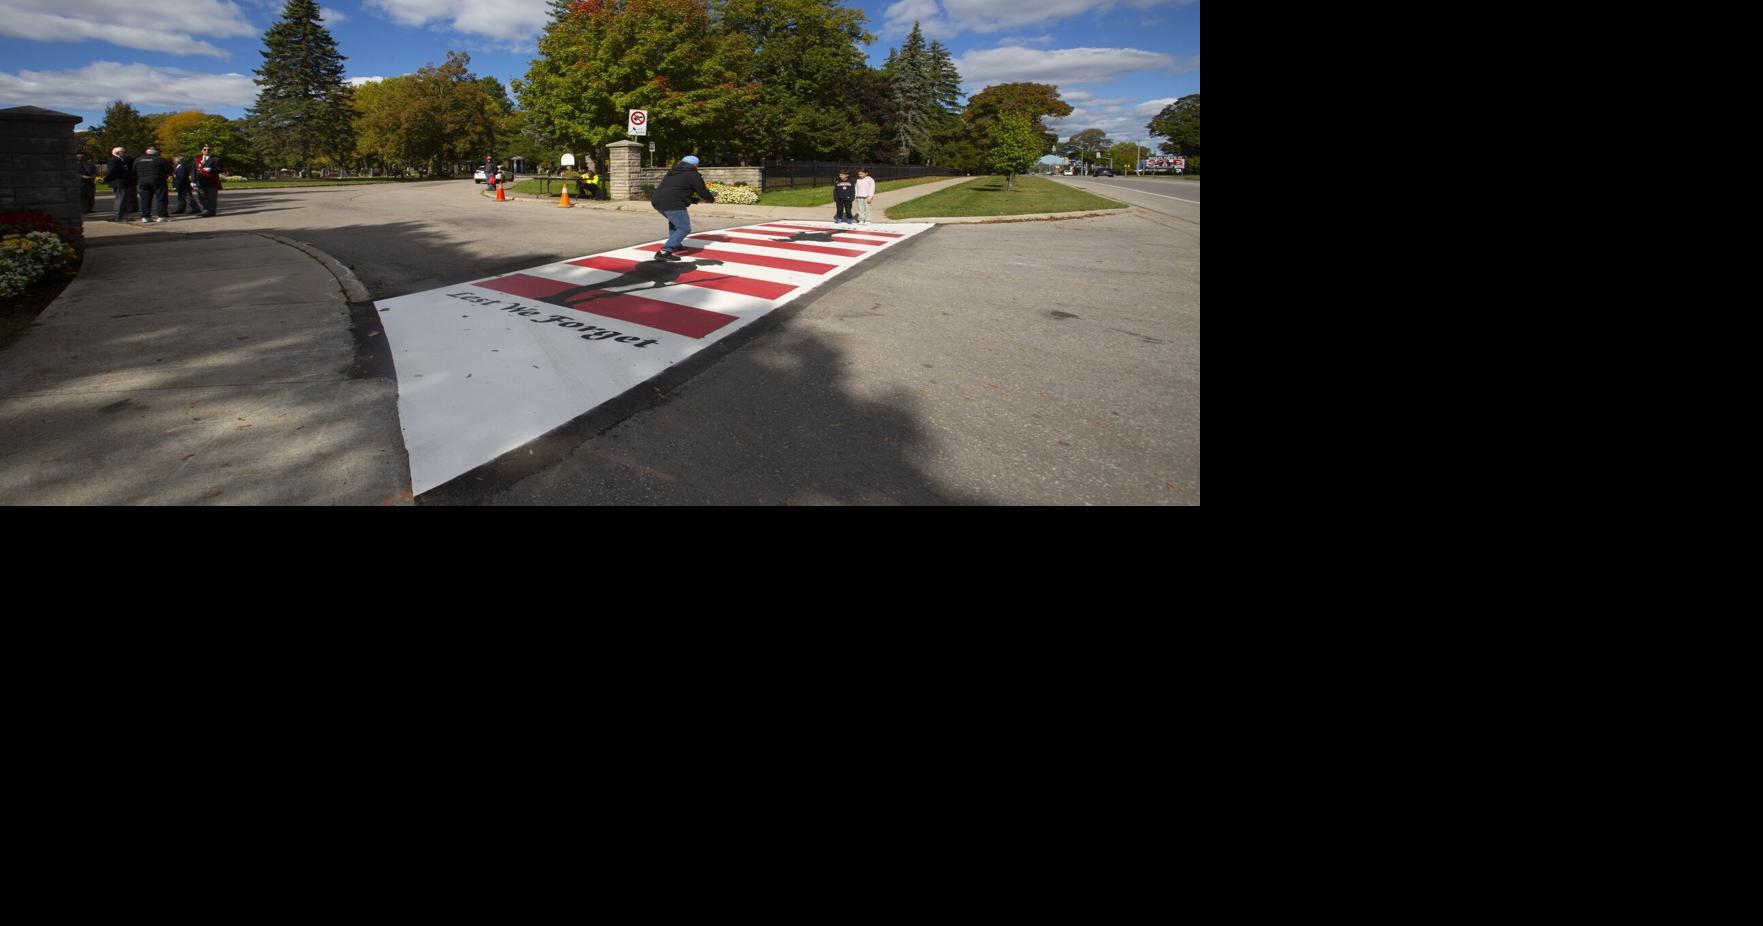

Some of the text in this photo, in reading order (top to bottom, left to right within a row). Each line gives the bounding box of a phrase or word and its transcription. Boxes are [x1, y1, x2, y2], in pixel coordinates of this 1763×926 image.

[447, 291, 659, 348] Lest We Forget
